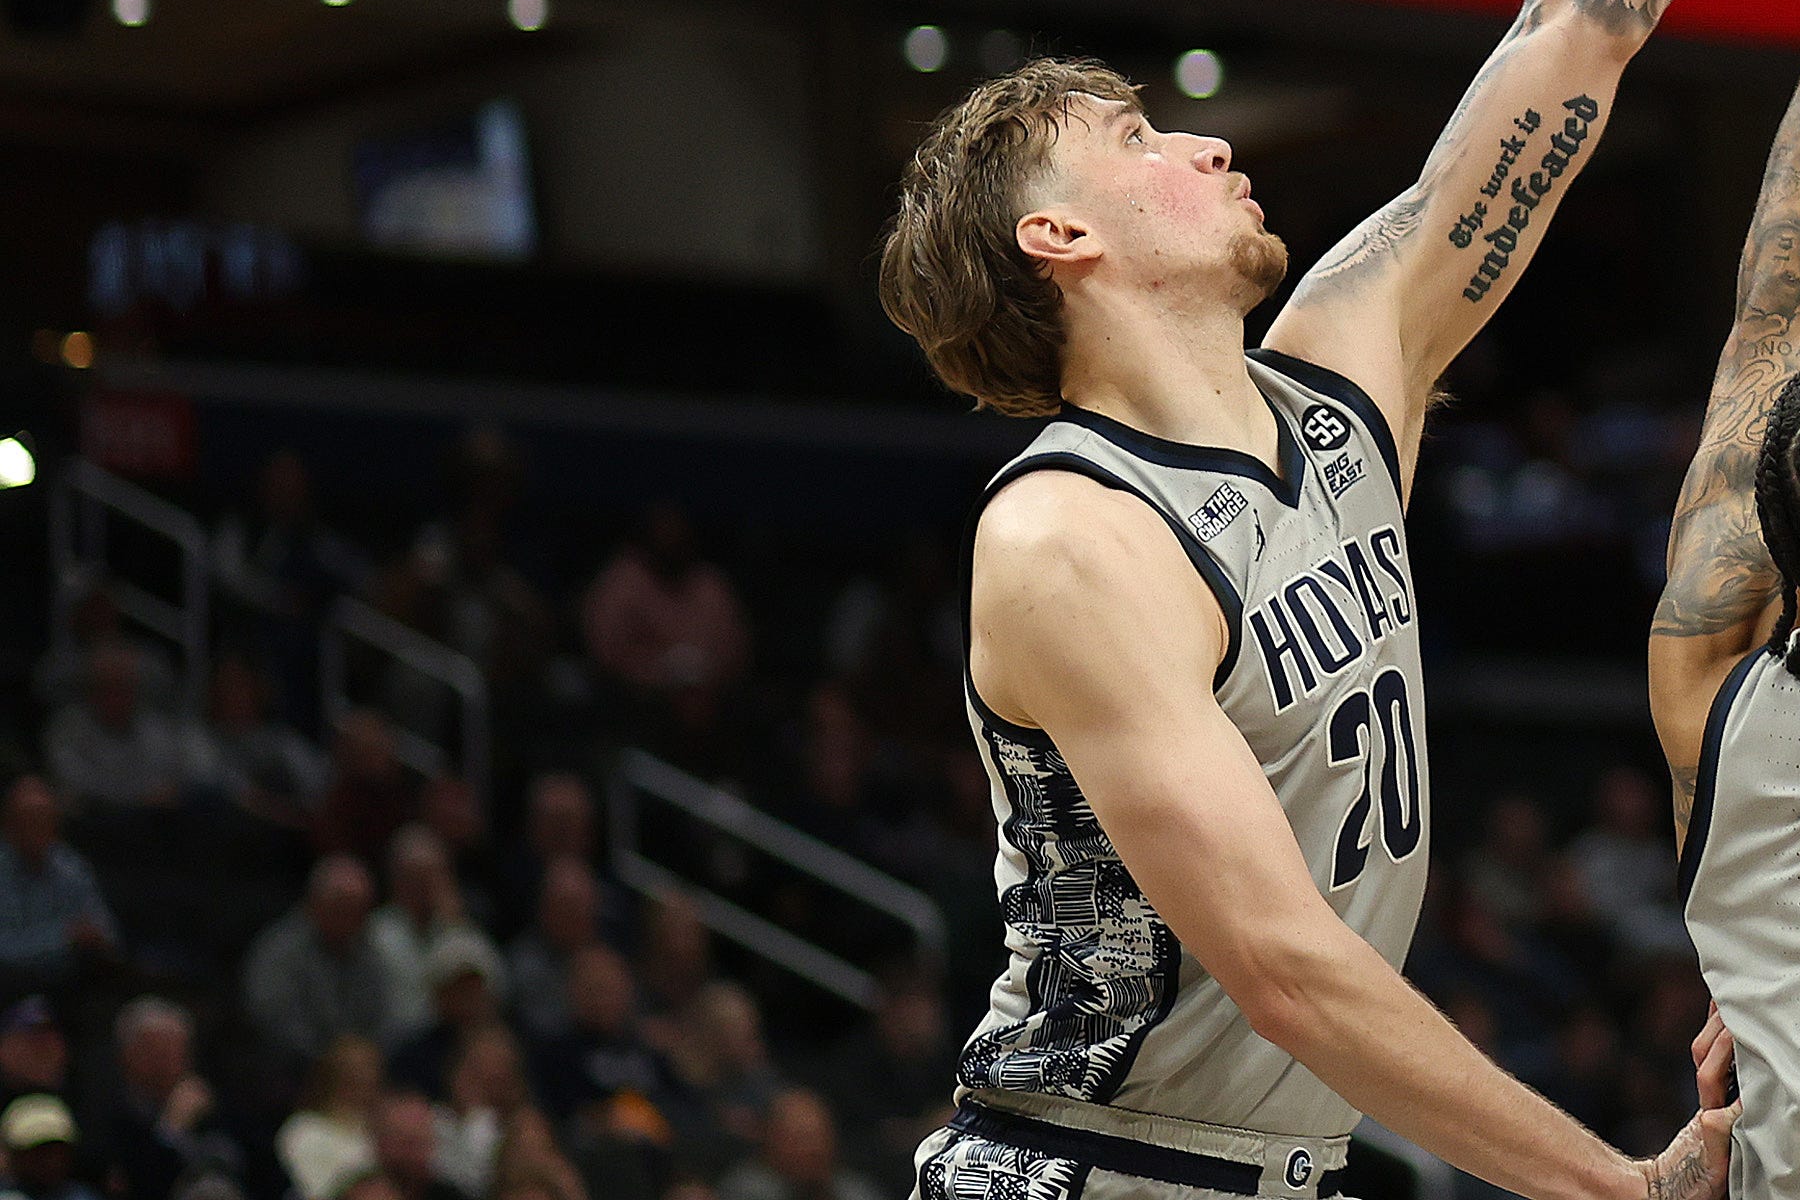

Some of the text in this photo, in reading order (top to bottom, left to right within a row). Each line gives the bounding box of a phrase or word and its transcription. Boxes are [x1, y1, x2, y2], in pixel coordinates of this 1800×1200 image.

[1480, 135, 1526, 199] work
[1514, 108, 1541, 135] is
[1462, 94, 1599, 303] undefeated
[1323, 452, 1350, 481] BIG
[1329, 458, 1365, 492] EAST
[1188, 483, 1235, 529] BE THE
[1197, 492, 1249, 542] CHANGE
[1245, 523, 1411, 716] HOYAS
[1327, 664, 1422, 892] 20
[1283, 1146, 1314, 1191] G
